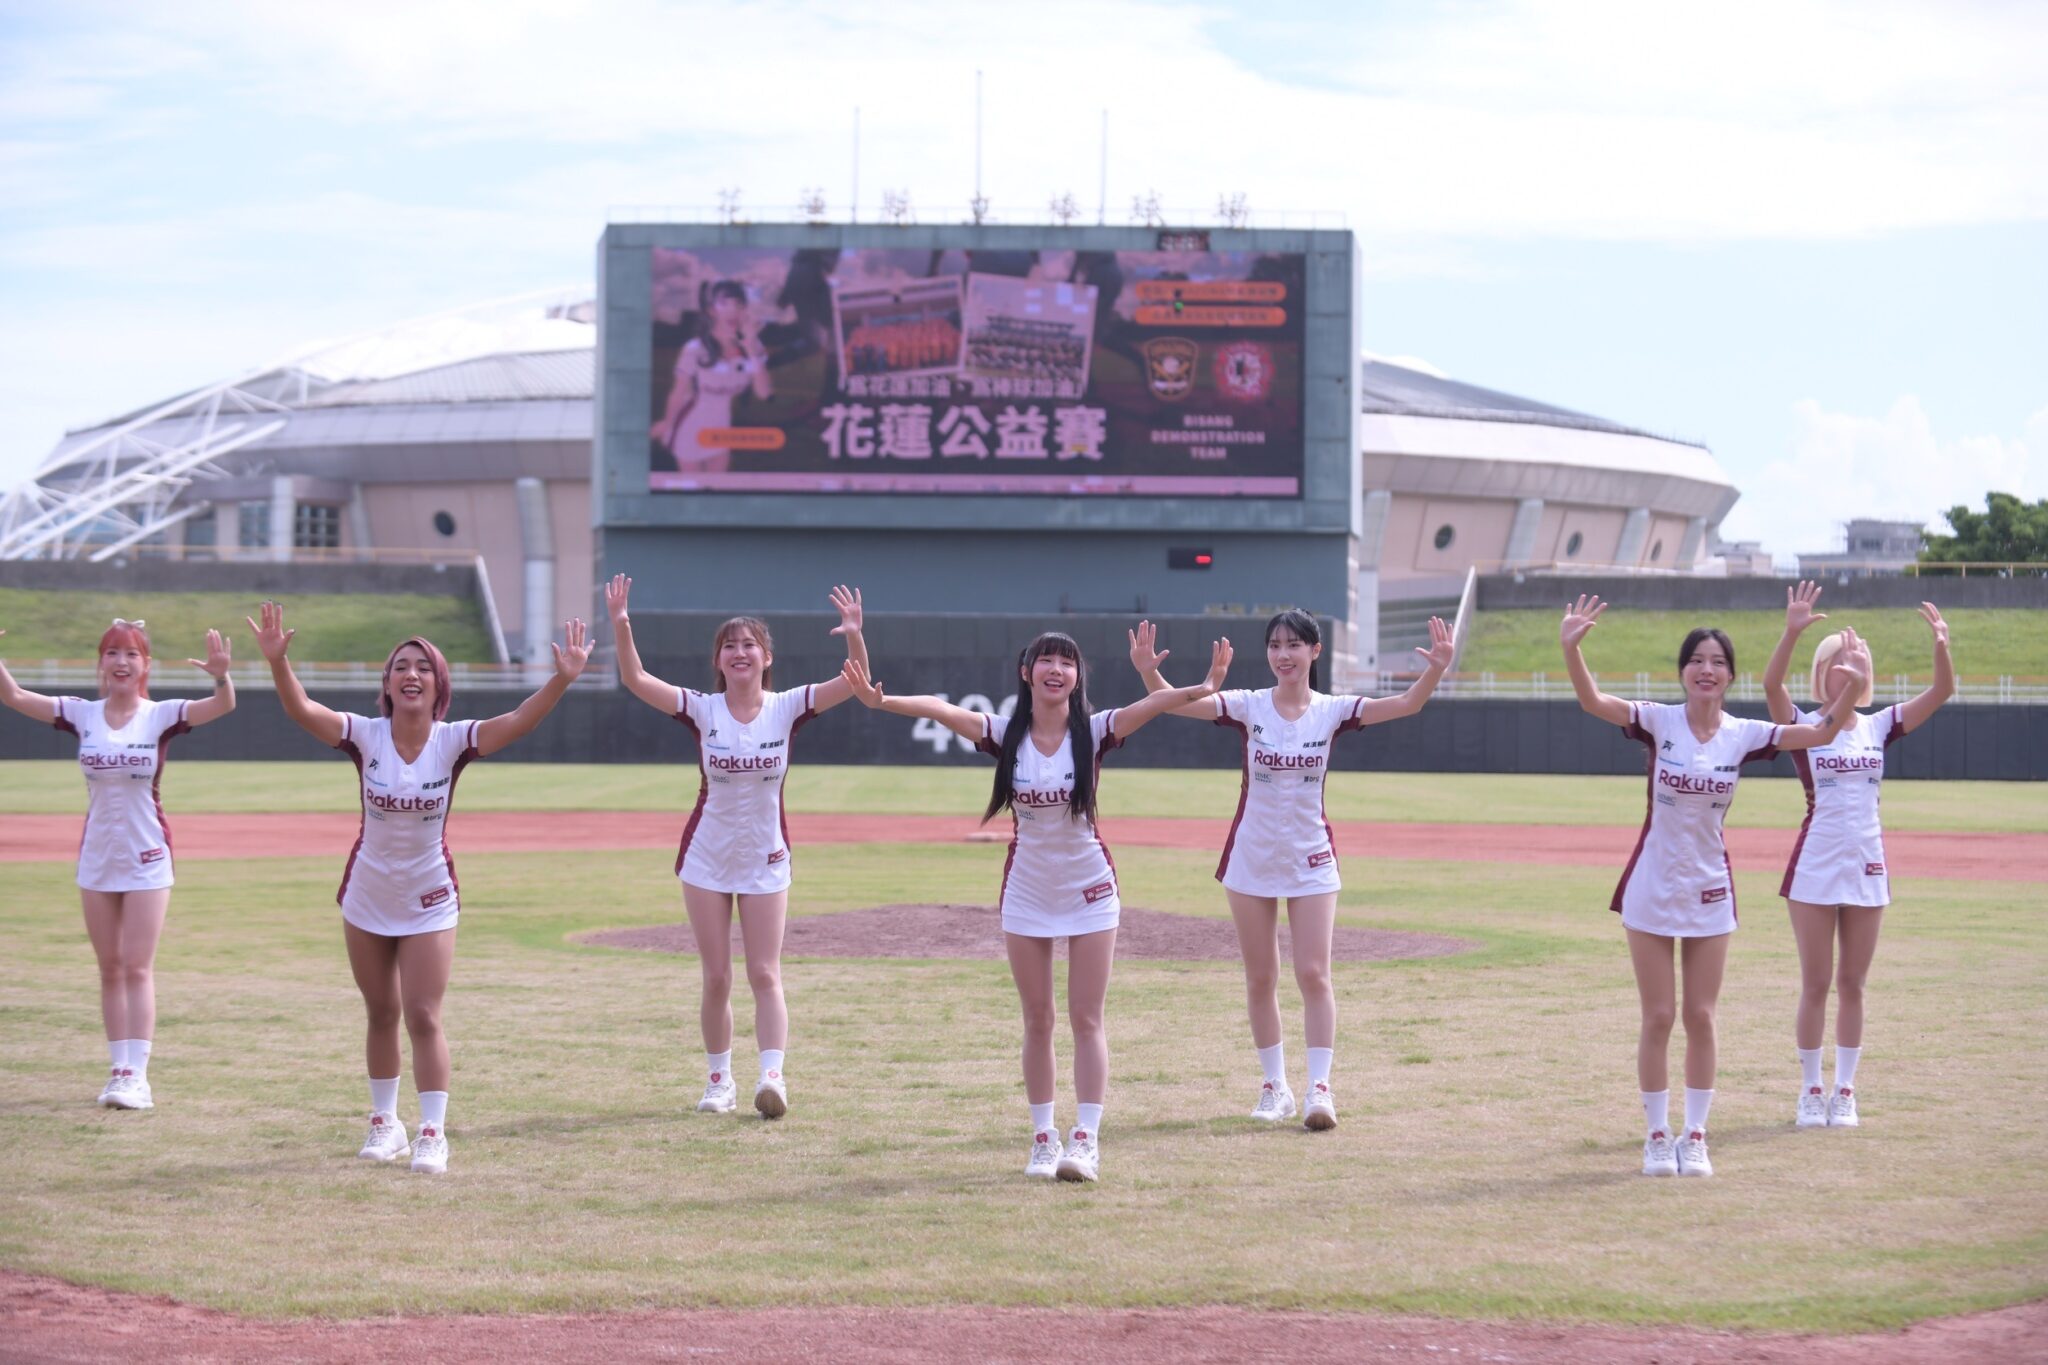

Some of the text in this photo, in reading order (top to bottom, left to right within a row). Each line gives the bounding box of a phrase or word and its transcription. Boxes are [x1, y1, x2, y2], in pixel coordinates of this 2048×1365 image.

[820, 403, 1106, 460] 花蓮公益賽
[1151, 431, 1266, 444] DEMONSTRATION
[1190, 447, 1227, 459] TEAM
[912, 693, 1019, 753] 40
[709, 754, 781, 769] Rakuten
[1254, 750, 1323, 768] Rakuten
[1659, 769, 1733, 795] Rakuten
[366, 788, 445, 810] Rakuten
[1012, 788, 1075, 804] Rakut
